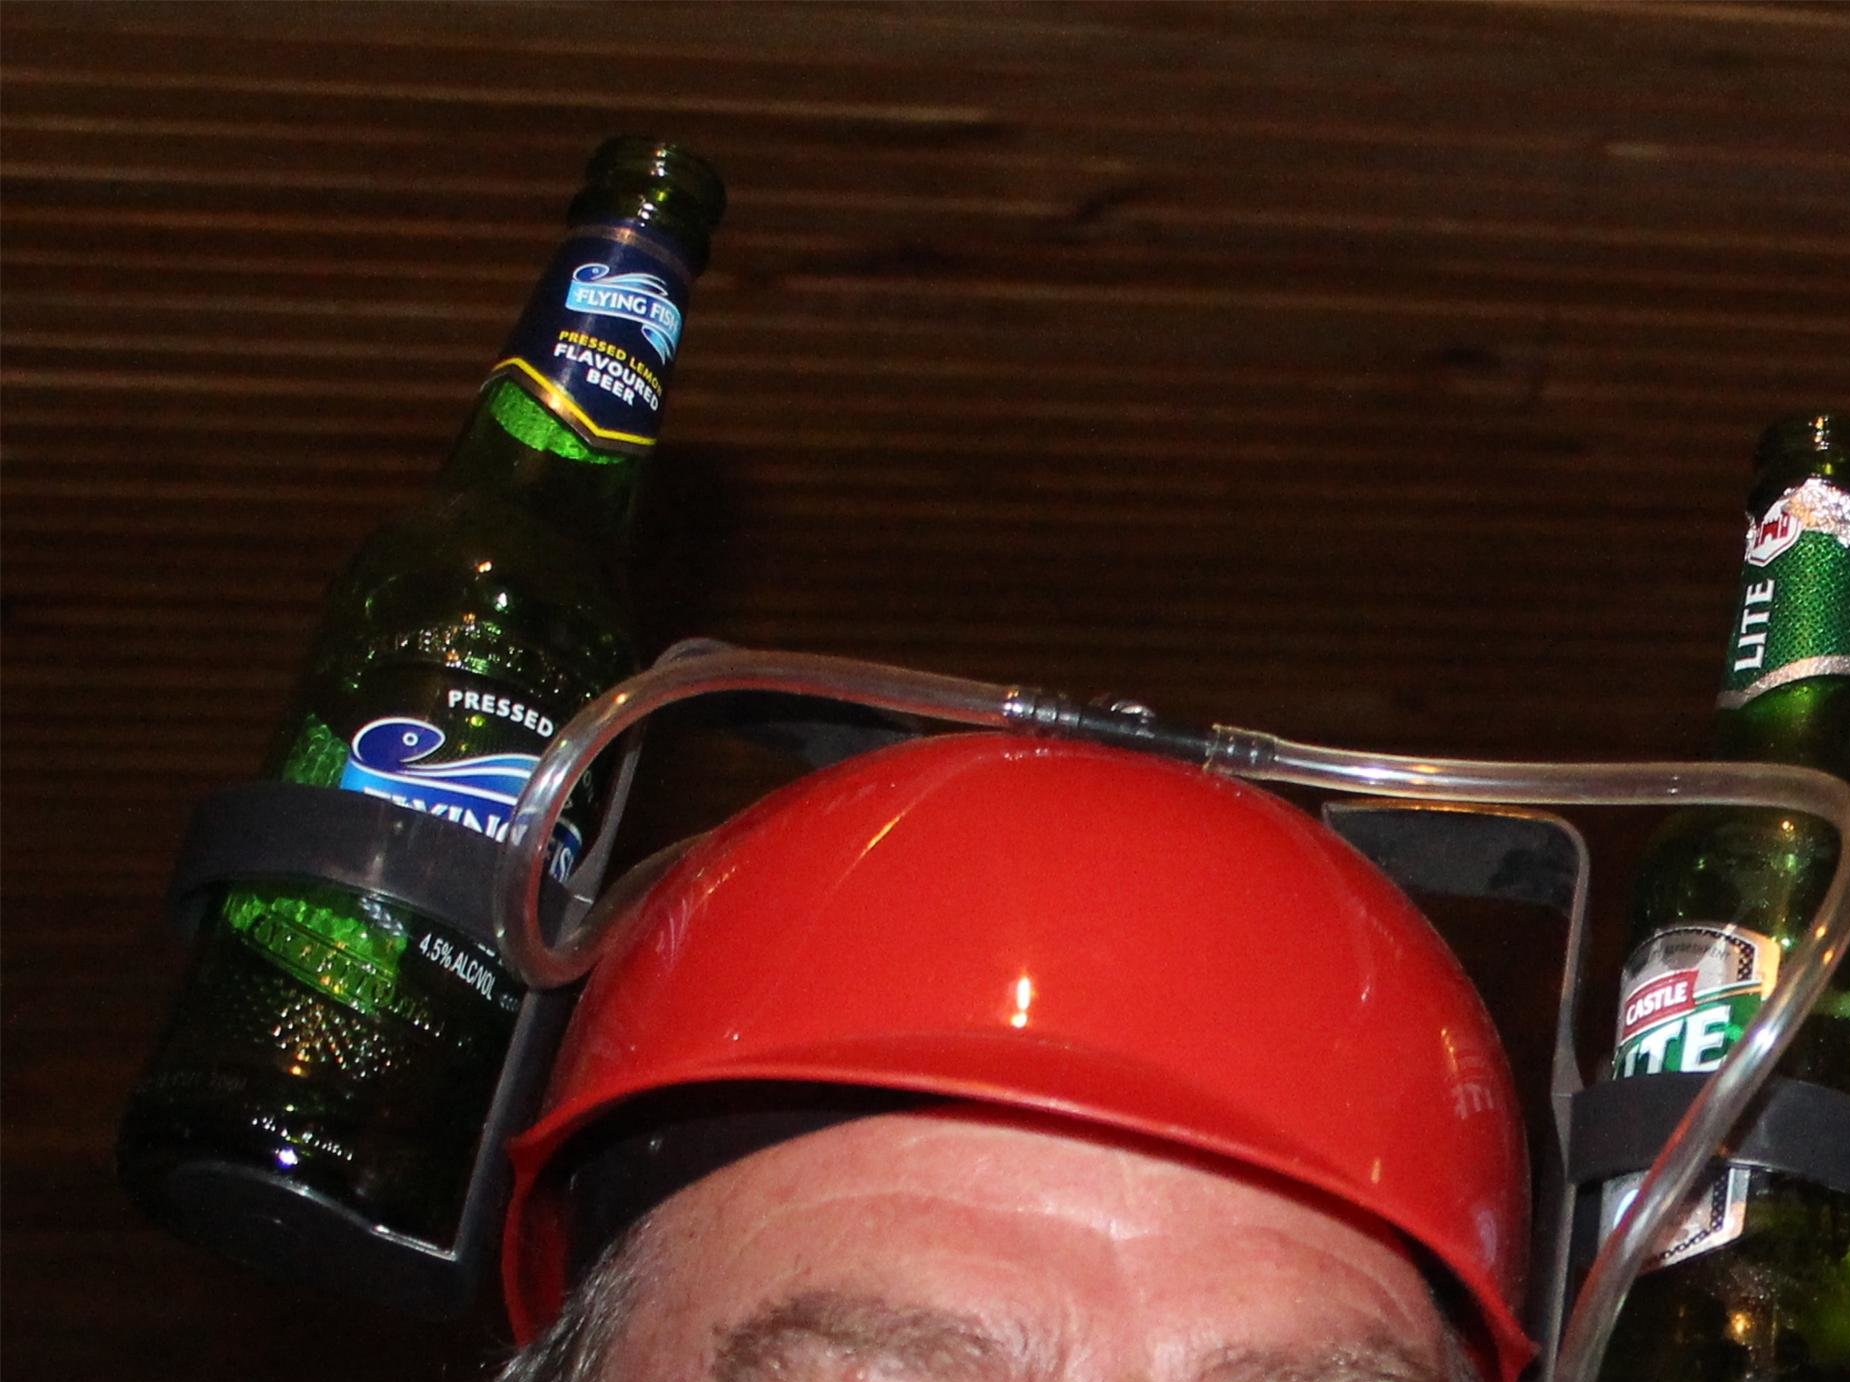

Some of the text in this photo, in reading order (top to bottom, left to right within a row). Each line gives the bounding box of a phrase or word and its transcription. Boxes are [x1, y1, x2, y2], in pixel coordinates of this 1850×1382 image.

[575, 289, 647, 315] FLYING
[559, 331, 627, 361] PRESSED
[554, 343, 659, 412] FLAVOURED
[586, 368, 636, 406] BEER
[1734, 578, 1775, 672] LITE
[447, 689, 555, 738] PRESSED
[1625, 980, 1687, 1026] CASTLE
